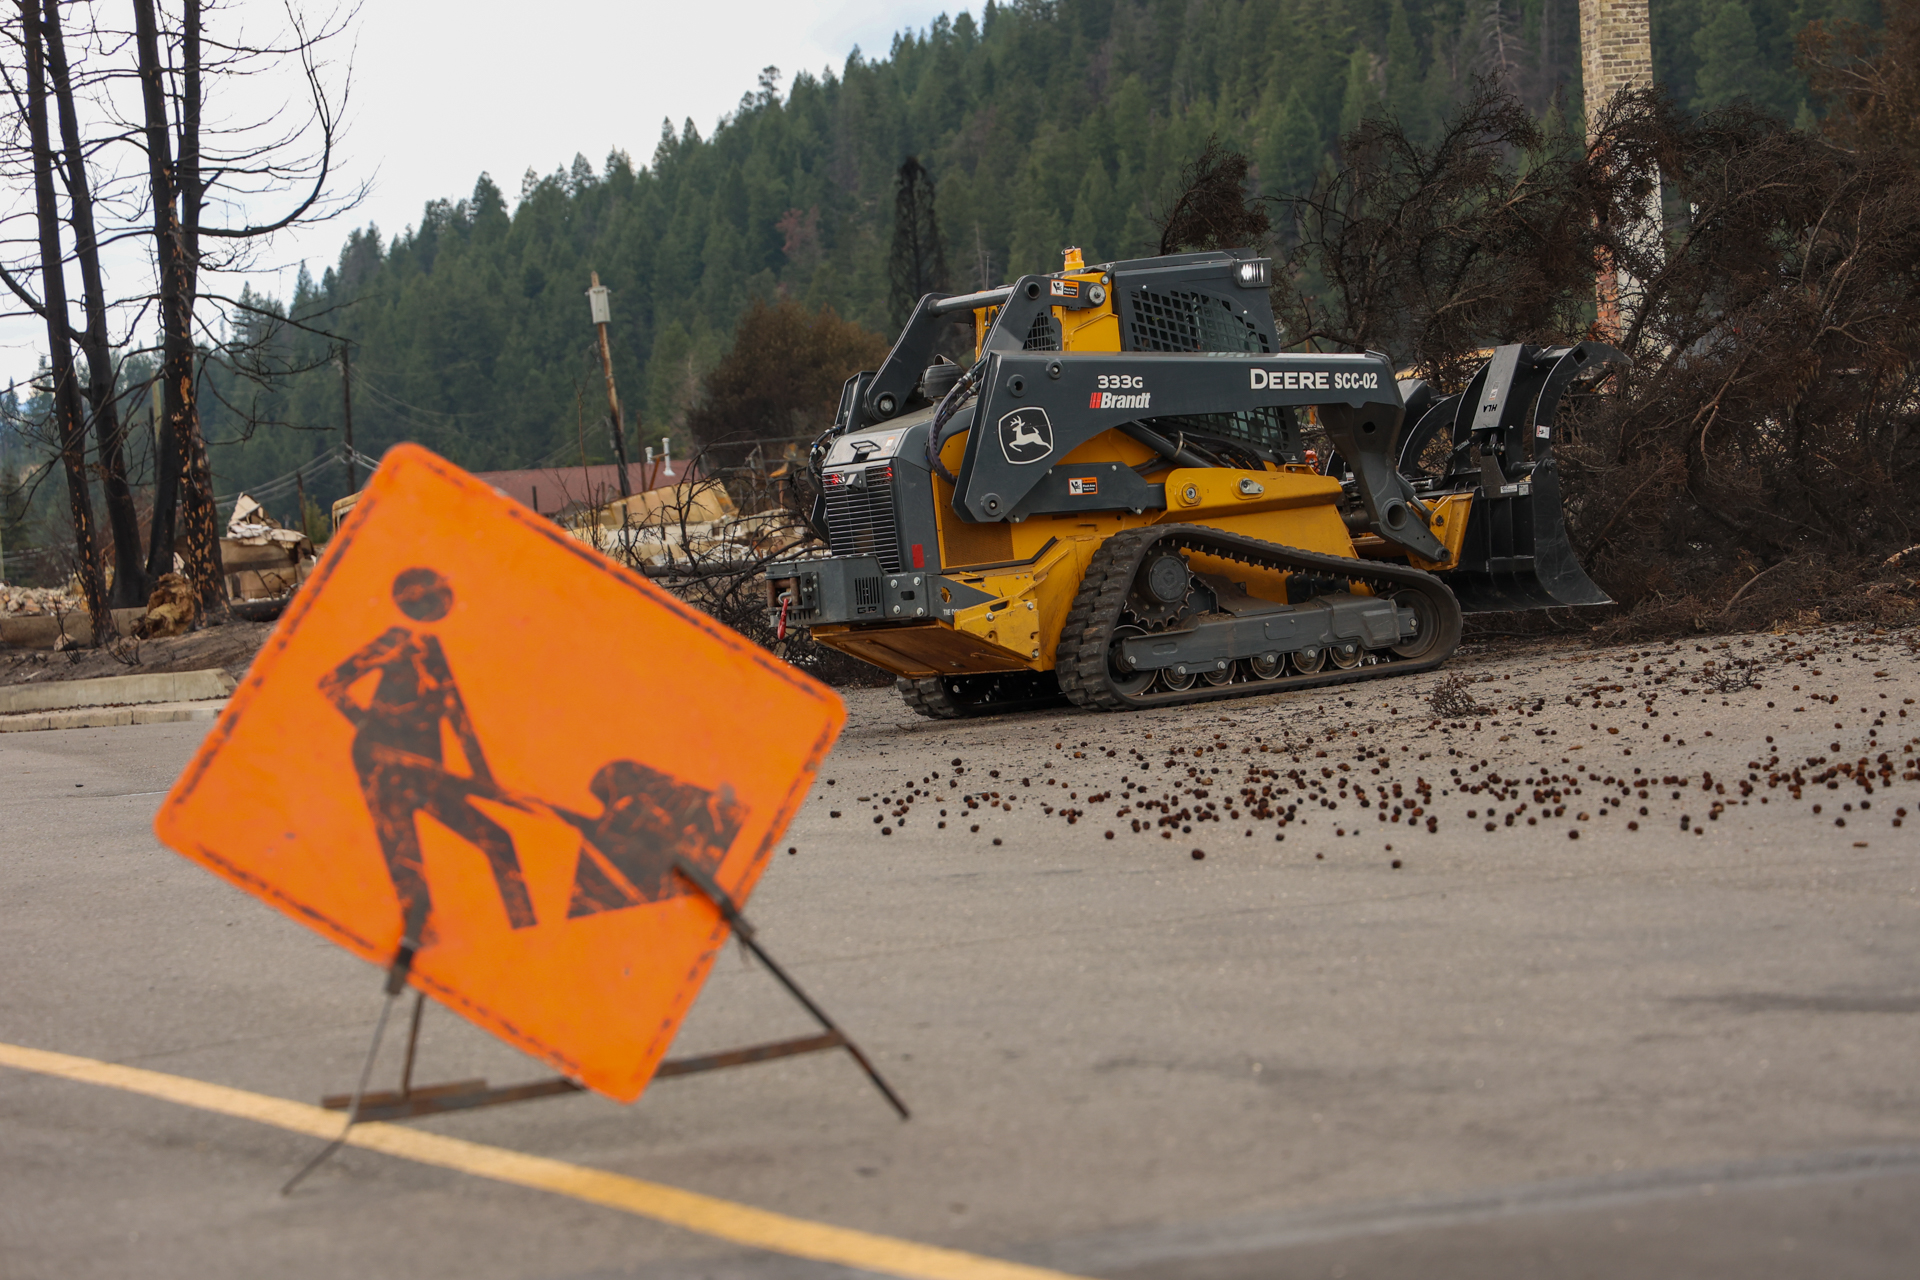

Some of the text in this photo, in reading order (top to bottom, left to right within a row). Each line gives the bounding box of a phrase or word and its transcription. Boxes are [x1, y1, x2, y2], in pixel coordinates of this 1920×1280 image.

[1097, 374, 1143, 389] 333G
[1250, 368, 1378, 389] DEERE SCC-02
[1100, 391, 1151, 409] Brandt
[1483, 404, 1498, 413] HLA
